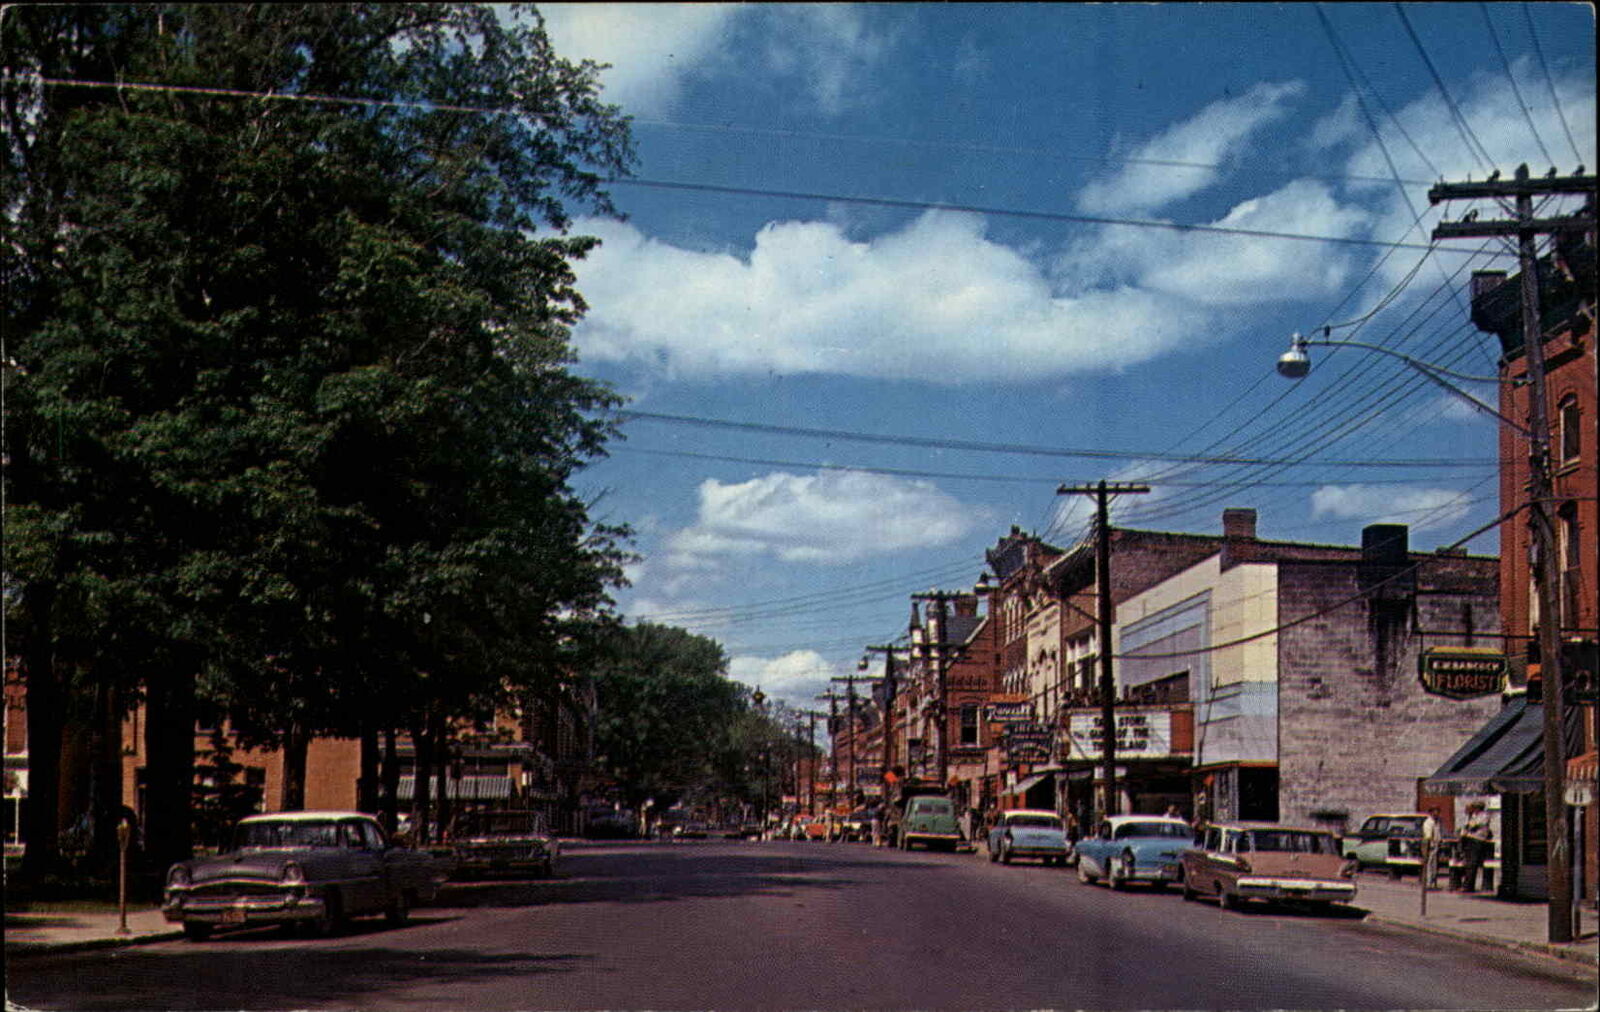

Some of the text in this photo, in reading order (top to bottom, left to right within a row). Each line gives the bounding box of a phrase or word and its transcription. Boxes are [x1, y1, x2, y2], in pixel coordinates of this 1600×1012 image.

[1436, 672, 1495, 690] FLORIST
[1117, 715, 1146, 727] STORY
[1133, 726, 1148, 738] THE
